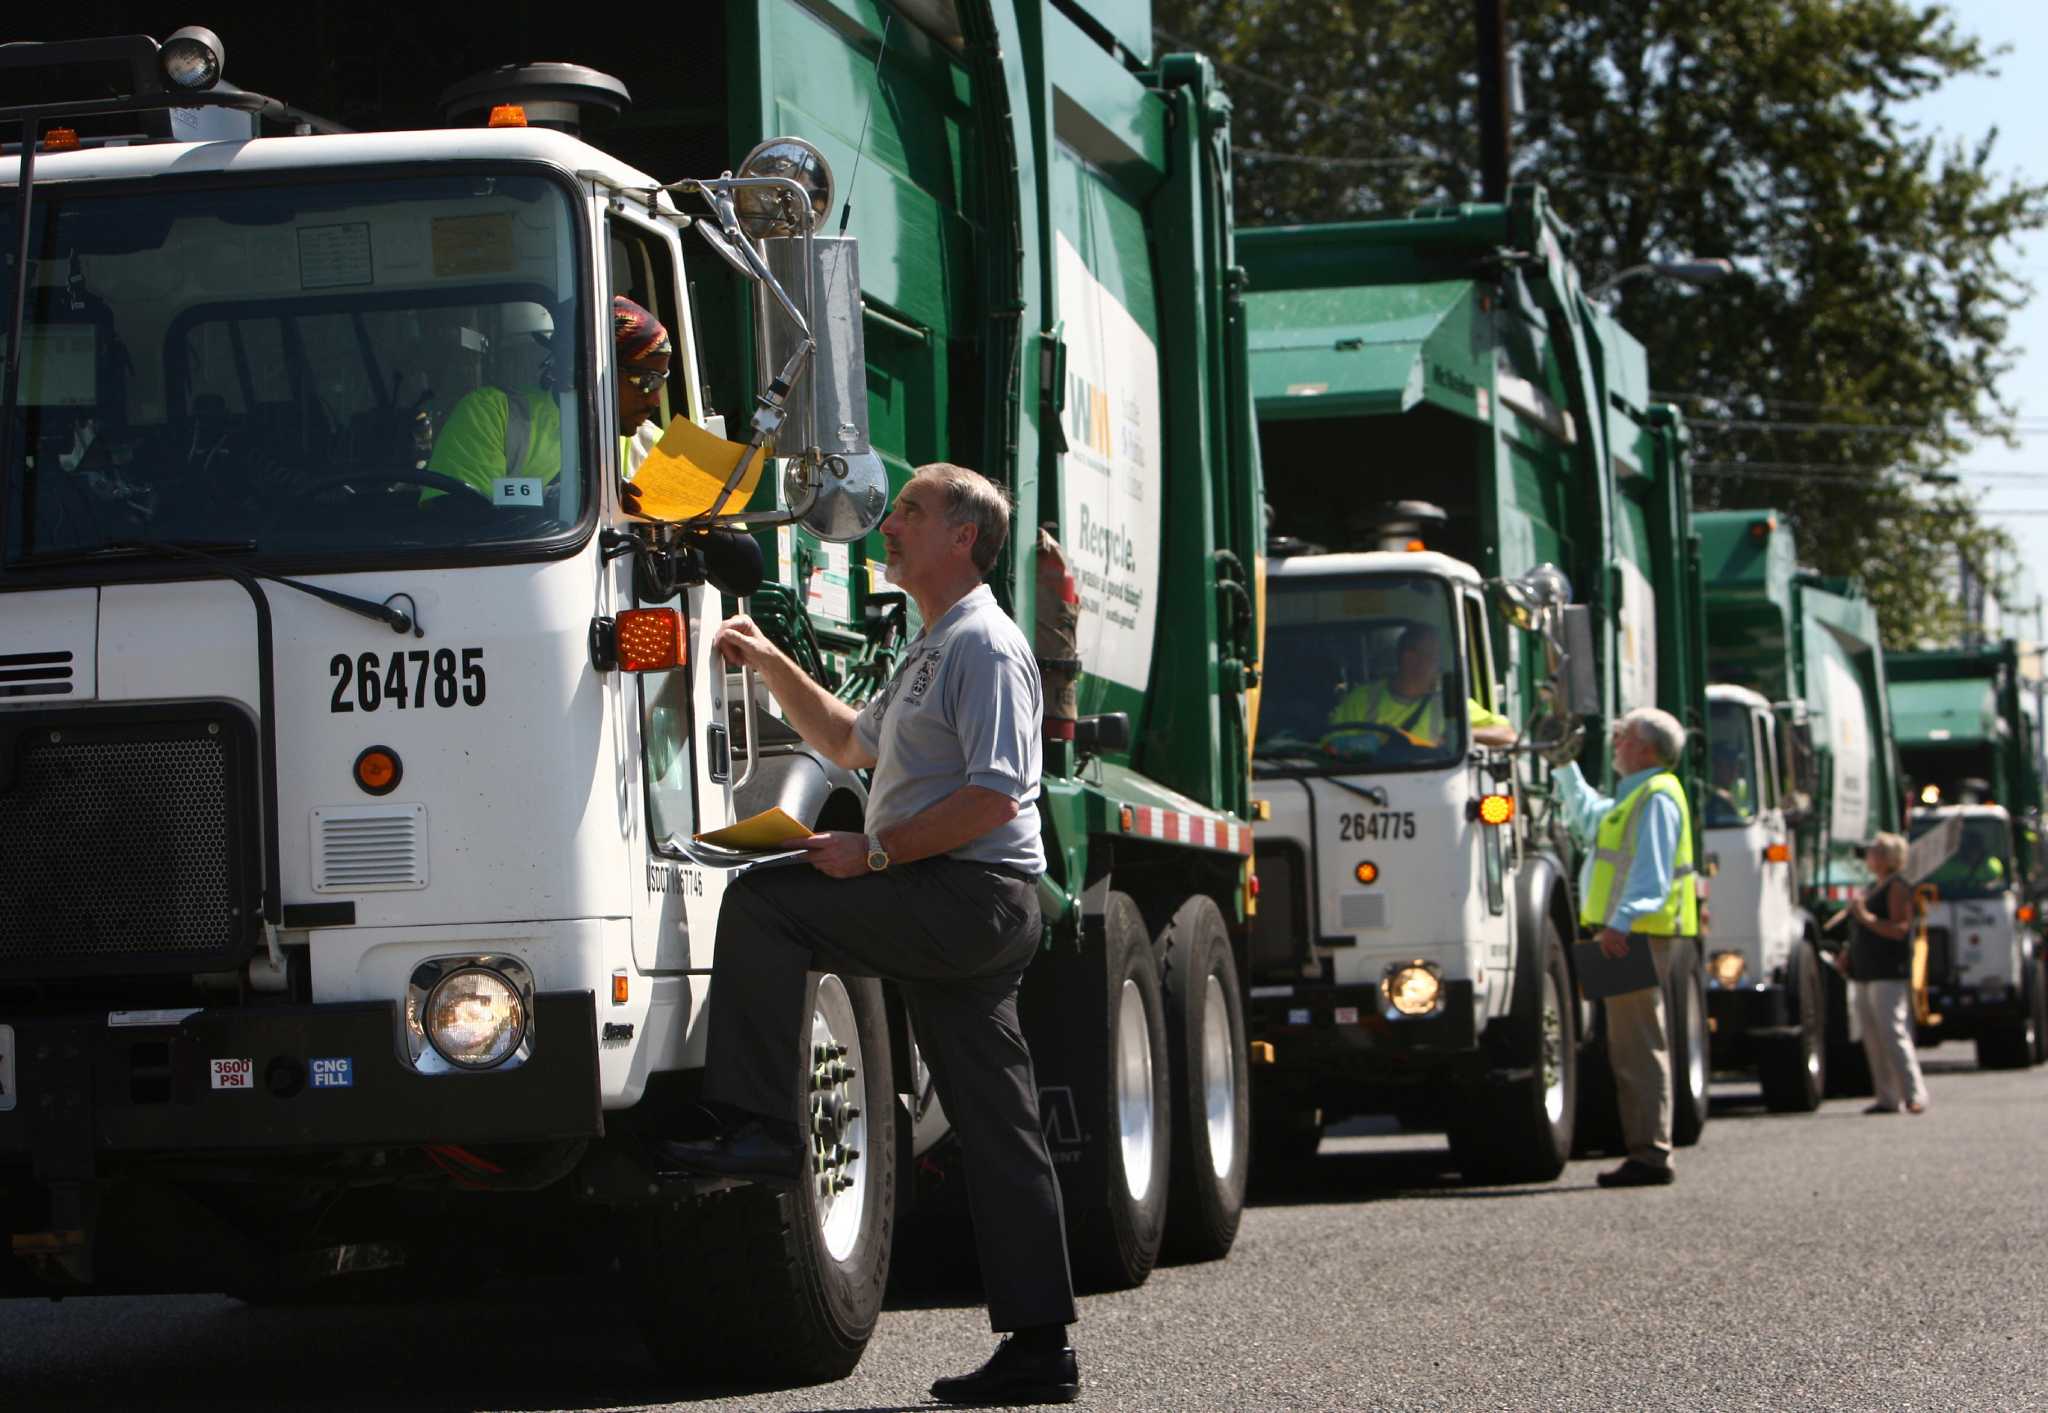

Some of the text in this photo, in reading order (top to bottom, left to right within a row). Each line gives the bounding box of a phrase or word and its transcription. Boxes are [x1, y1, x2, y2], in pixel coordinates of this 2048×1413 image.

[504, 484, 530, 496] E 6
[330, 647, 486, 713] 264785
[1340, 811, 1416, 841] 264775
[646, 864, 670, 893] USDOT
[214, 1060, 250, 1073] 3600
[313, 1060, 348, 1073] CNG
[220, 1074, 245, 1086] PSI
[315, 1073, 348, 1086] FILL
